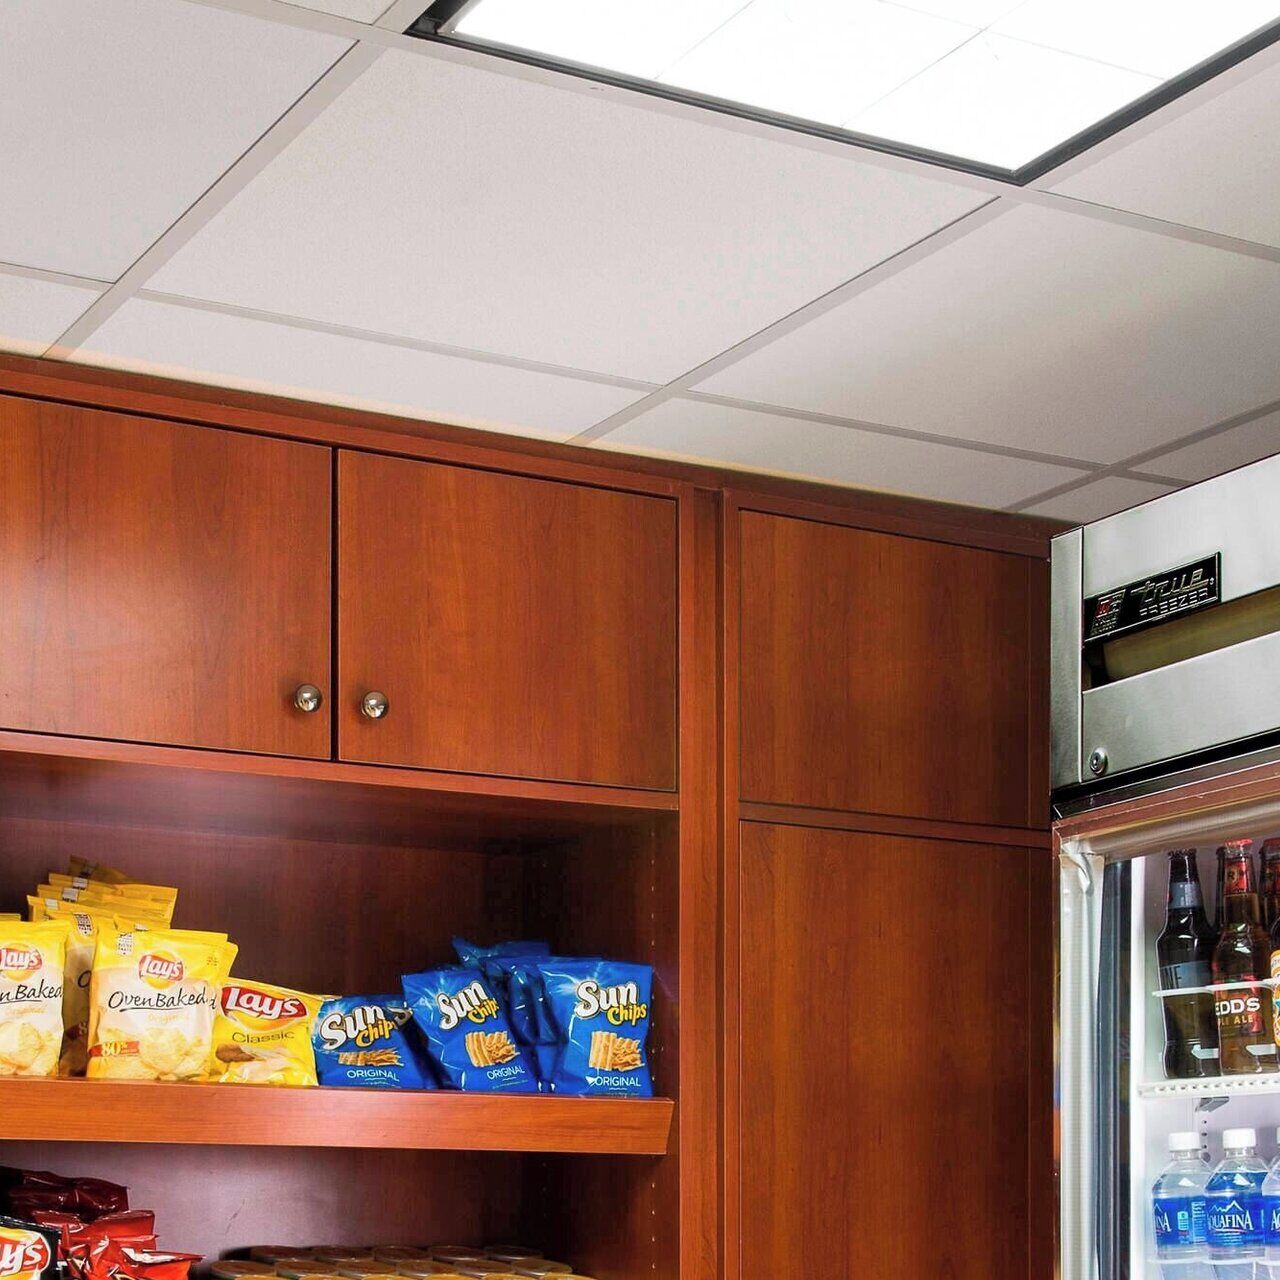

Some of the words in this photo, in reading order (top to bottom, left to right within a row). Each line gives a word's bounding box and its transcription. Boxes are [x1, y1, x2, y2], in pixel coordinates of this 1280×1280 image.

[1139, 589, 1209, 617] FREEZER
[108, 990, 152, 1009] Oven
[156, 986, 208, 1007] Baked
[437, 980, 488, 1030] Sun
[574, 980, 638, 1019] Sun
[606, 1002, 646, 1026] Chips
[1233, 1014, 1254, 1025] ALE
[231, 1030, 296, 1044] Classic
[320, 1004, 386, 1050] Sun
[101, 1041, 120, 1056] 80
[347, 1068, 400, 1083] ORIGINAL
[487, 1065, 525, 1080] ORIGINAL
[596, 1076, 641, 1088] ORIGINAL
[1208, 1209, 1253, 1231] QUAFINA
